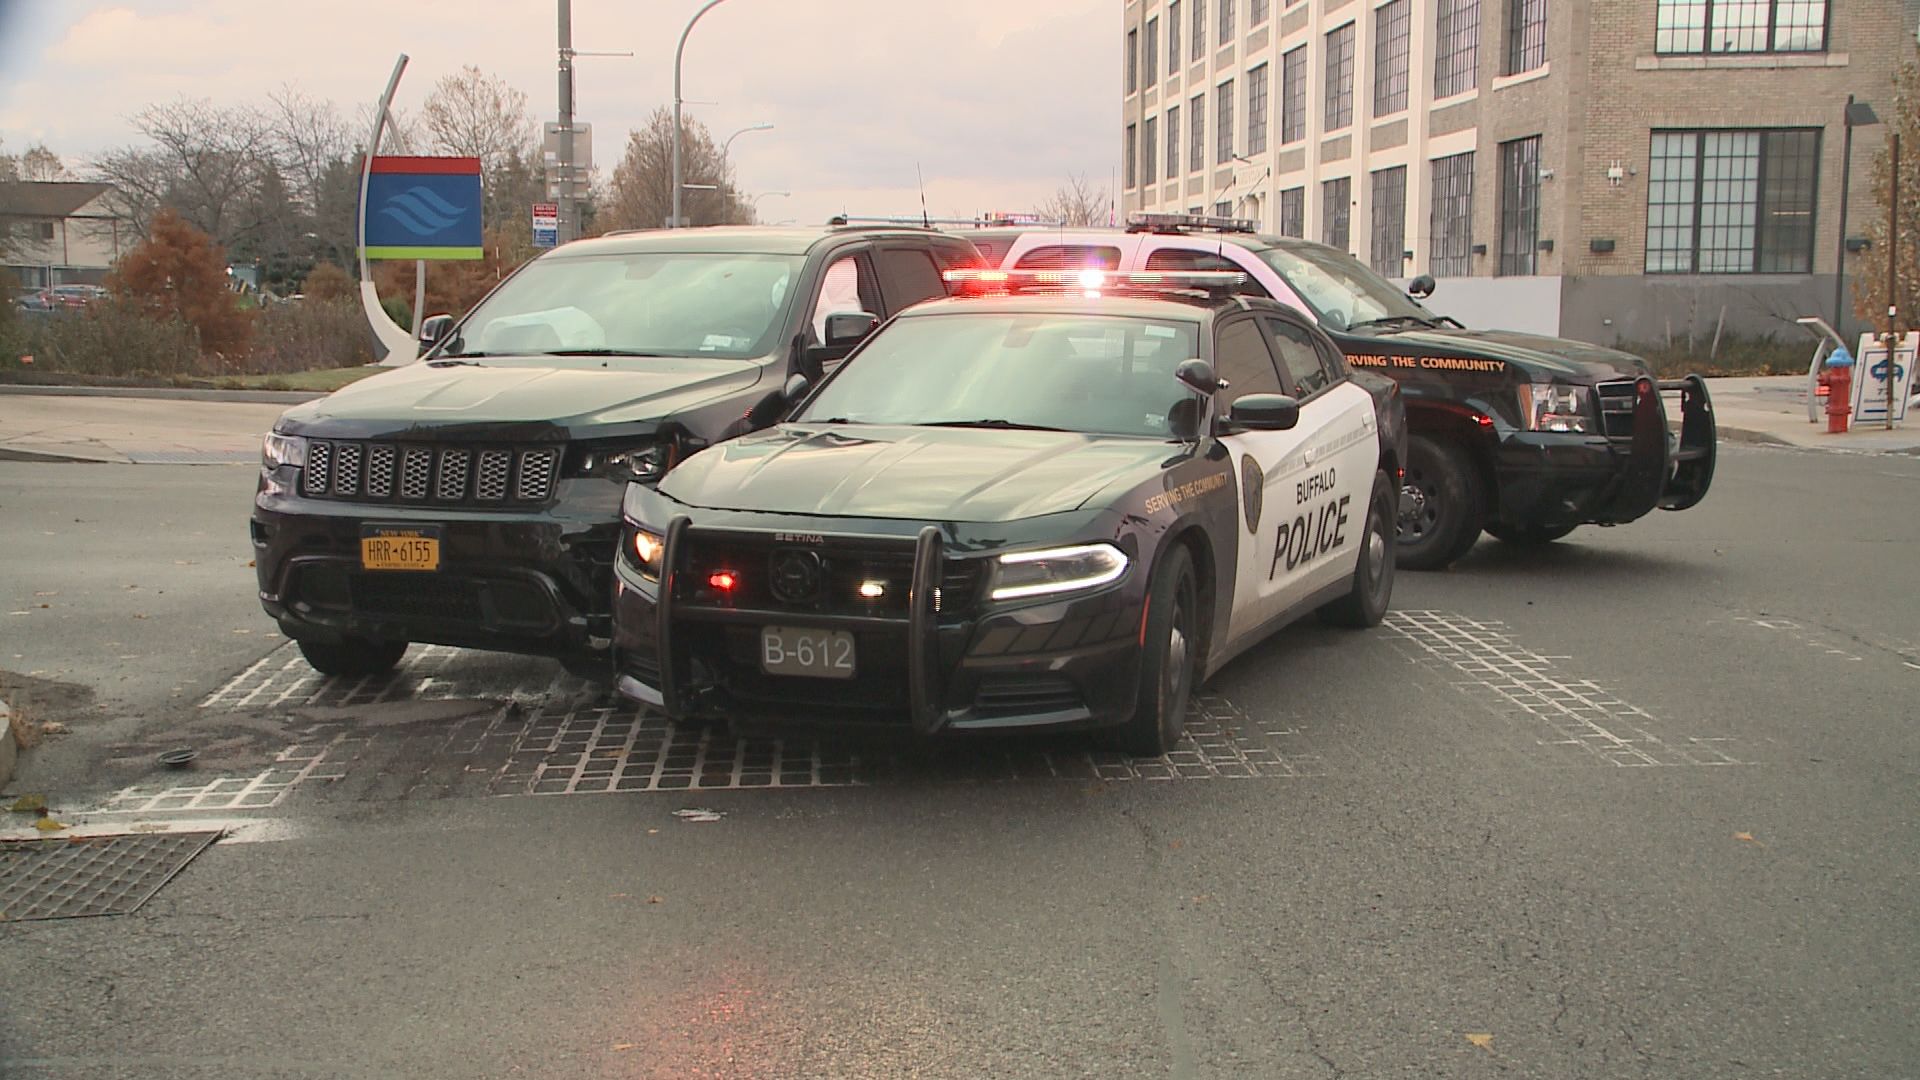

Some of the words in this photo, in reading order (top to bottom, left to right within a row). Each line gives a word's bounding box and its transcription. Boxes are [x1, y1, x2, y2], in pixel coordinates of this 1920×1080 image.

[1344, 354, 1387, 367] RVING
[1390, 355, 1416, 368] THE
[1420, 356, 1505, 372] COMMUNITY
[1145, 487, 1182, 514] SERVING
[1180, 482, 1195, 499] THE
[1296, 467, 1336, 504] BUFFALO
[775, 533, 825, 544] SETINA
[1269, 494, 1351, 581] POLICE
[764, 634, 852, 668] B-612
